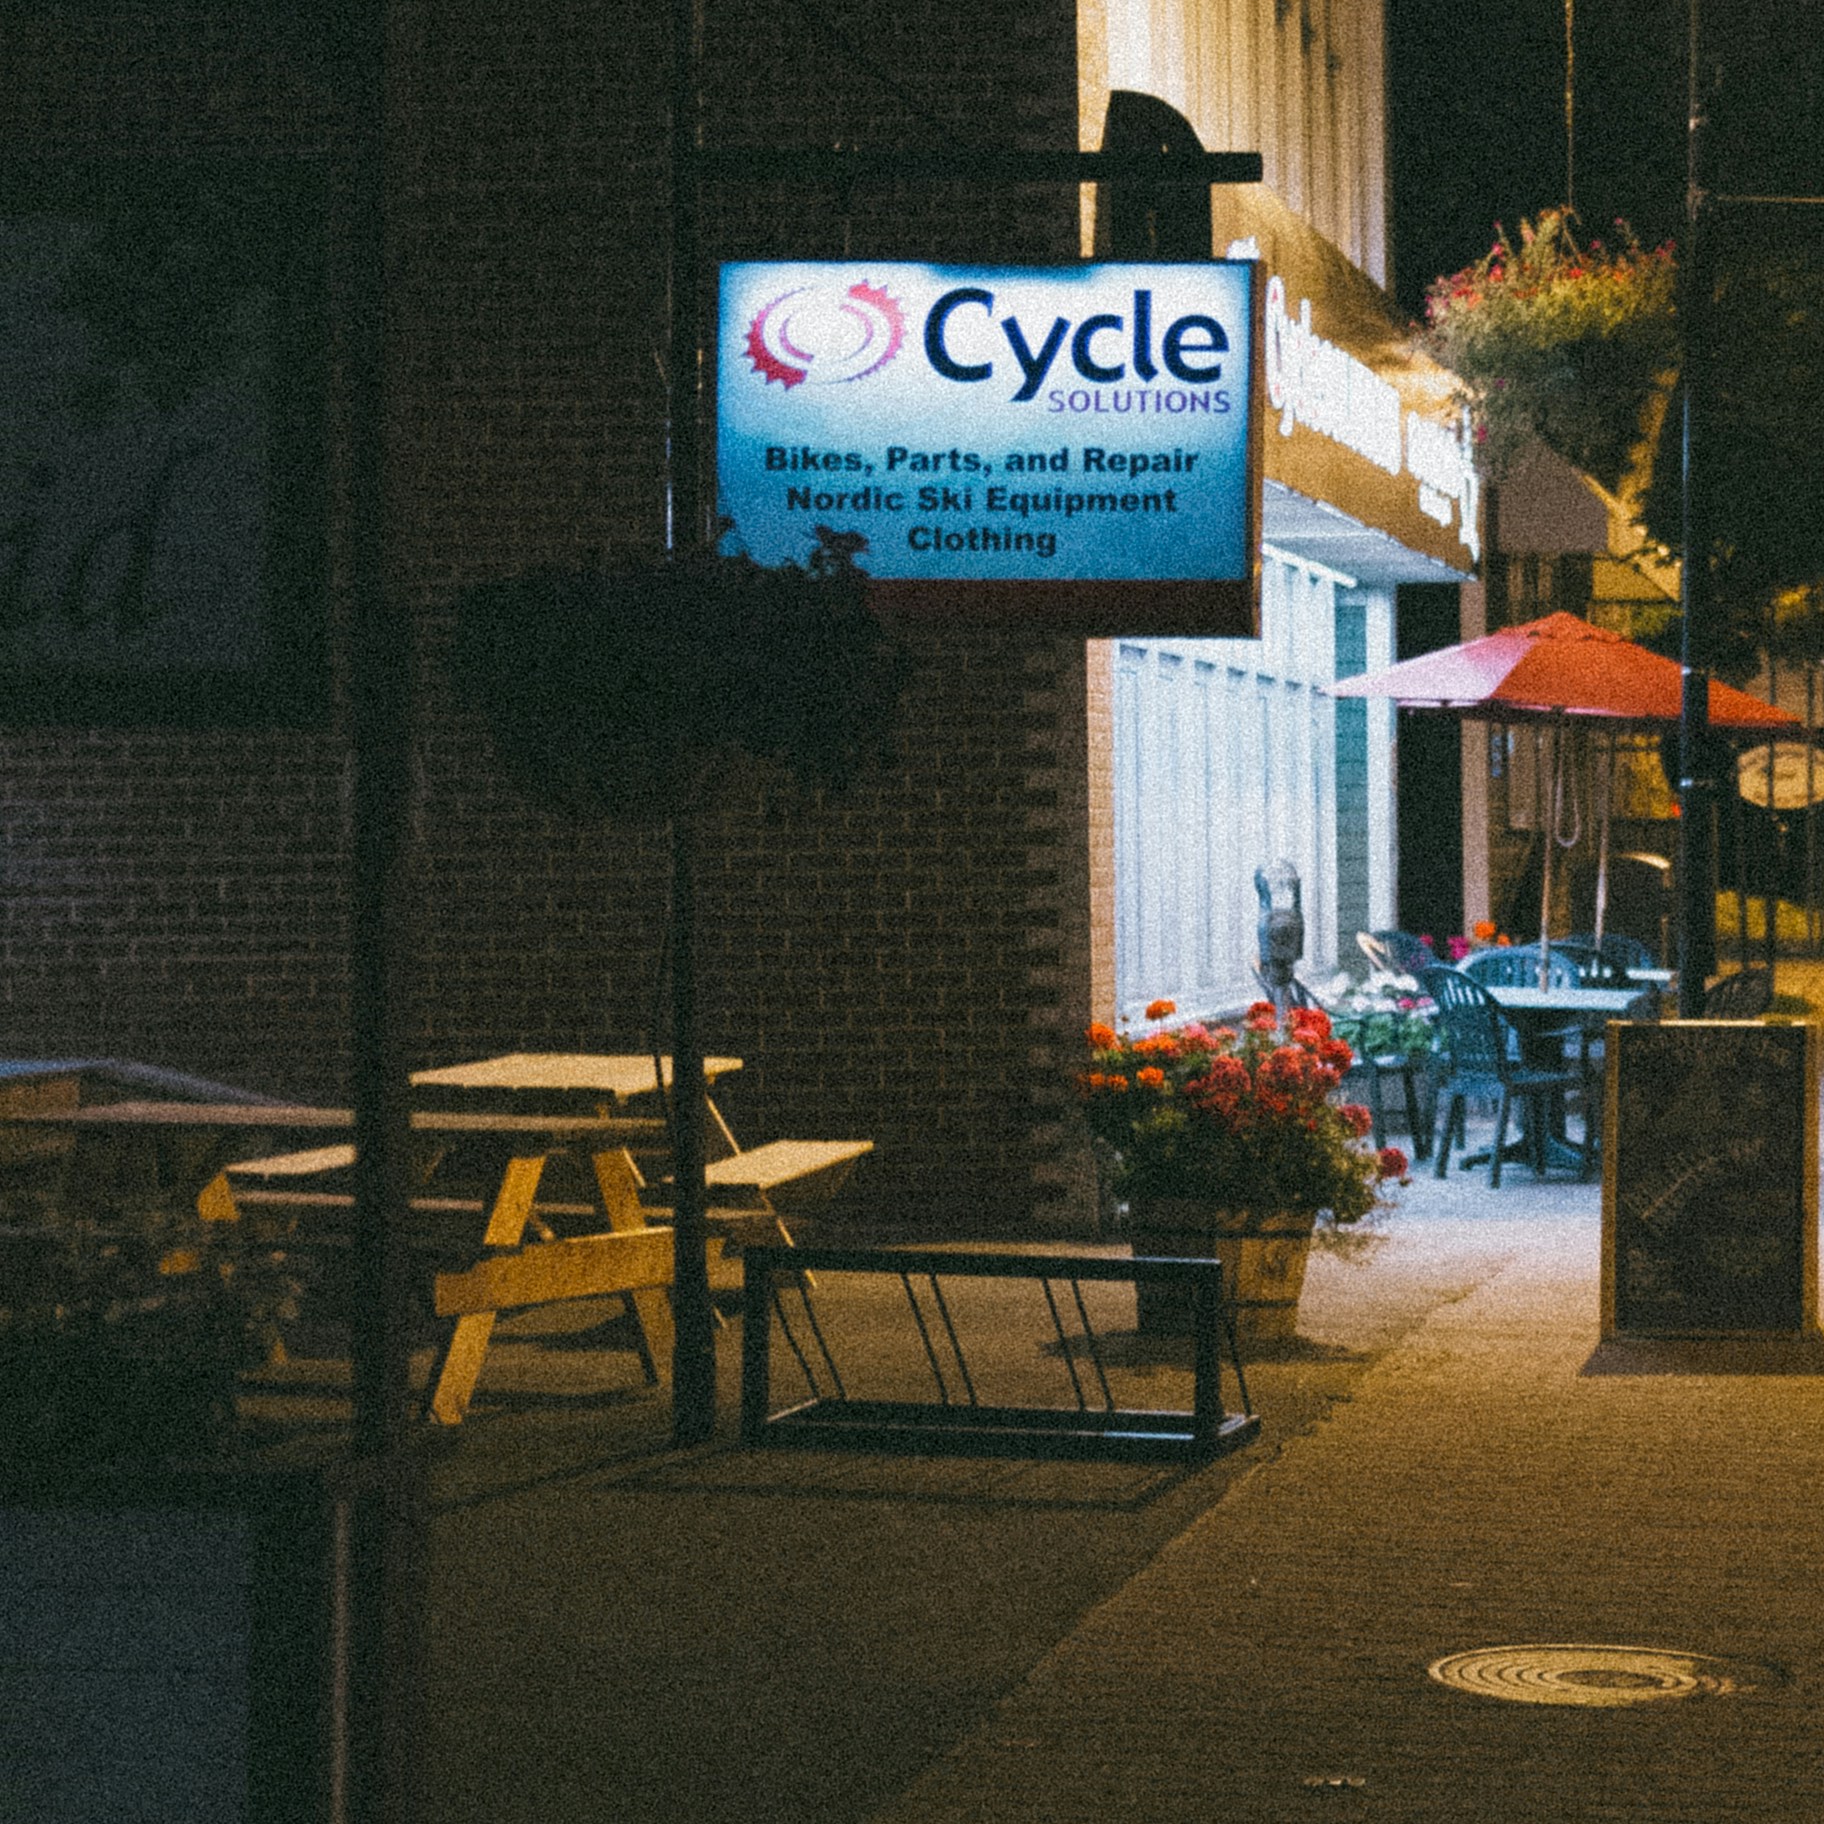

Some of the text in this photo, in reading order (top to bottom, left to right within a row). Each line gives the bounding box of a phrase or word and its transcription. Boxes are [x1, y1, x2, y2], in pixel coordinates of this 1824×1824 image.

[923, 286, 1231, 403] Cycle
[1048, 389, 1232, 415] SOLUTIONS
[765, 446, 1200, 479] Bikes, Parts, and Repair
[786, 485, 1178, 517] Nordic Ski Equipment
[907, 524, 1058, 558] Clothing
